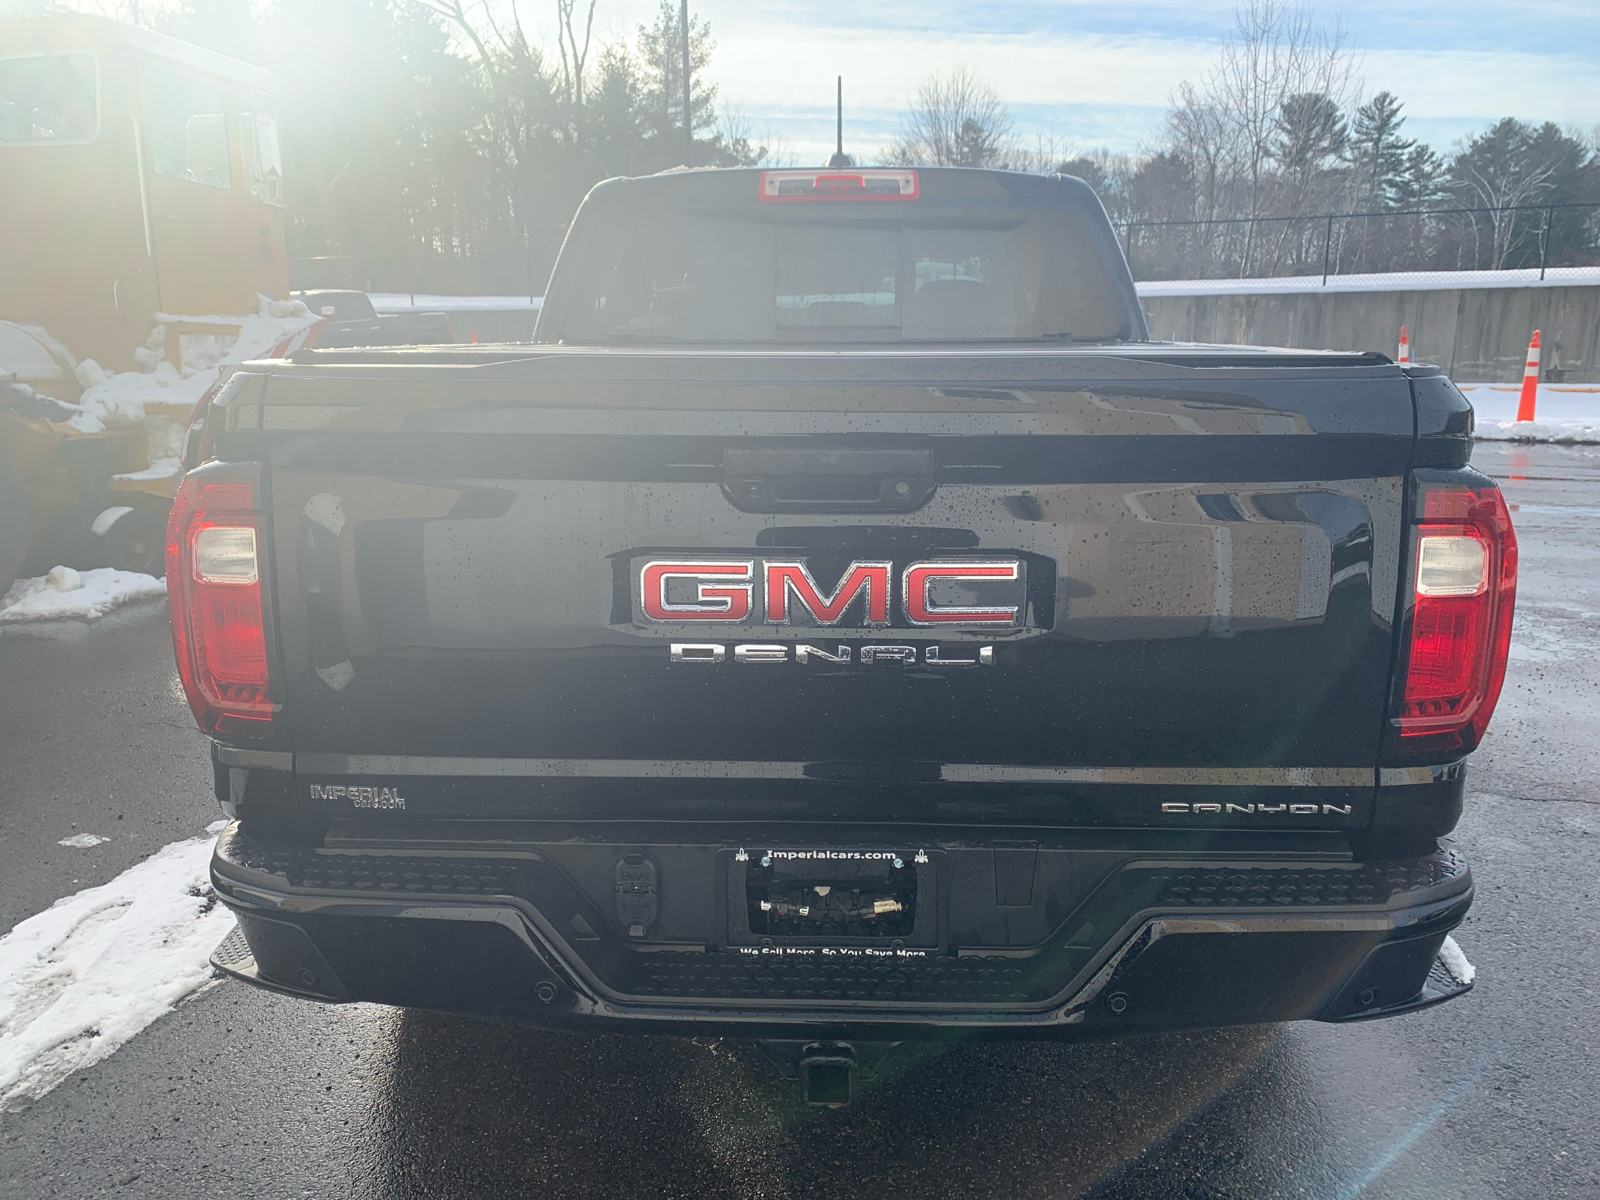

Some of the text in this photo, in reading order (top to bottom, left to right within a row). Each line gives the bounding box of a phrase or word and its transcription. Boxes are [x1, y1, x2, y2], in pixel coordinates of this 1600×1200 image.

[640, 559, 1020, 626] GMC
[670, 643, 995, 665] DENALI
[309, 783, 405, 802] IMPERIAL
[353, 799, 406, 810] cars.com
[1161, 802, 1352, 814] CANYON
[766, 850, 896, 860] Imperialcars.com
